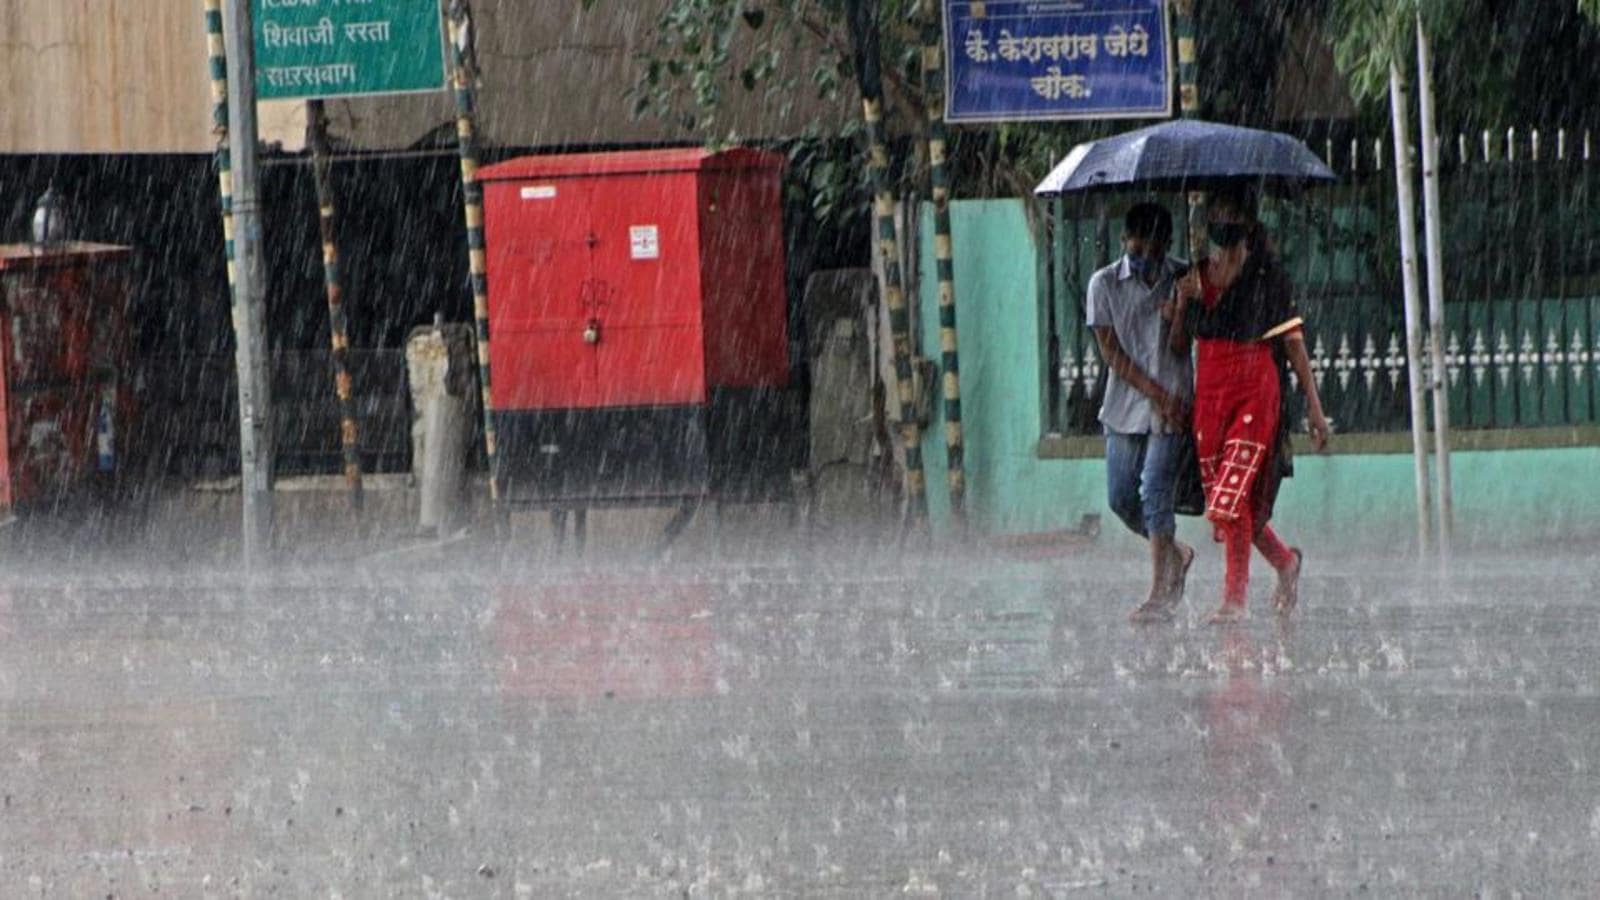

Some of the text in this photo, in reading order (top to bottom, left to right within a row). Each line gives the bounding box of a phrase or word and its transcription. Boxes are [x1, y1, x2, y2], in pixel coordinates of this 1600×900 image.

[262, 17, 390, 48] शिवाजी रस्ता
[1104, 24, 1148, 57] जेधे
